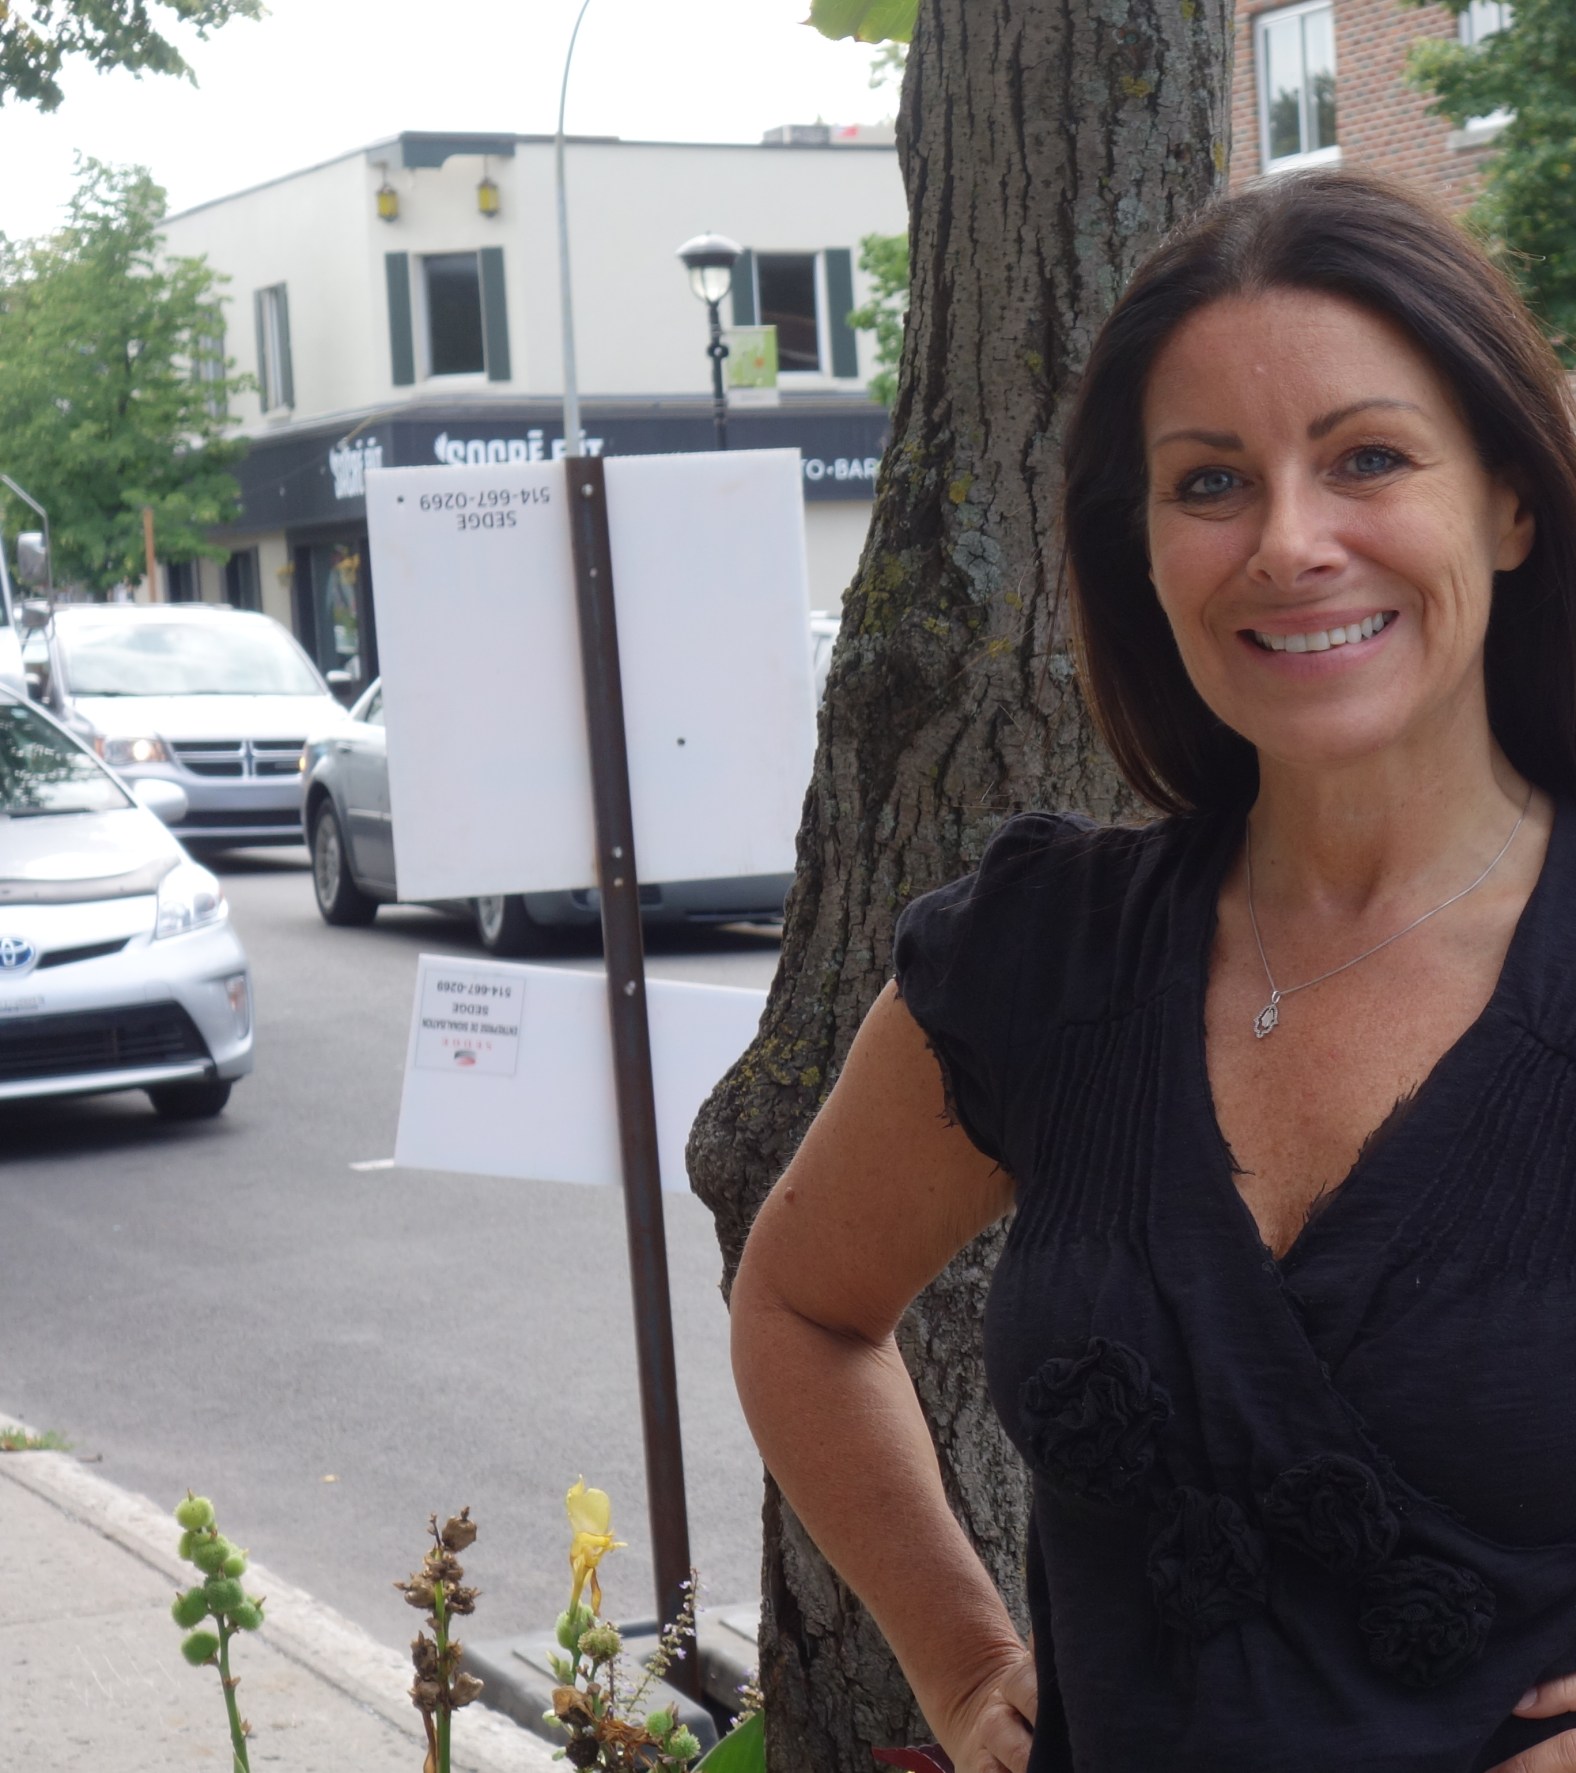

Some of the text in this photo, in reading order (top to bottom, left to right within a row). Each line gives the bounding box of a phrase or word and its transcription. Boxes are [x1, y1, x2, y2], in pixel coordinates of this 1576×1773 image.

[419, 486, 551, 512] 514-667-0269
[456, 510, 517, 531] SEDGE
[437, 980, 512, 998] 514-667-0269
[452, 1002, 489, 1016] SEDGE
